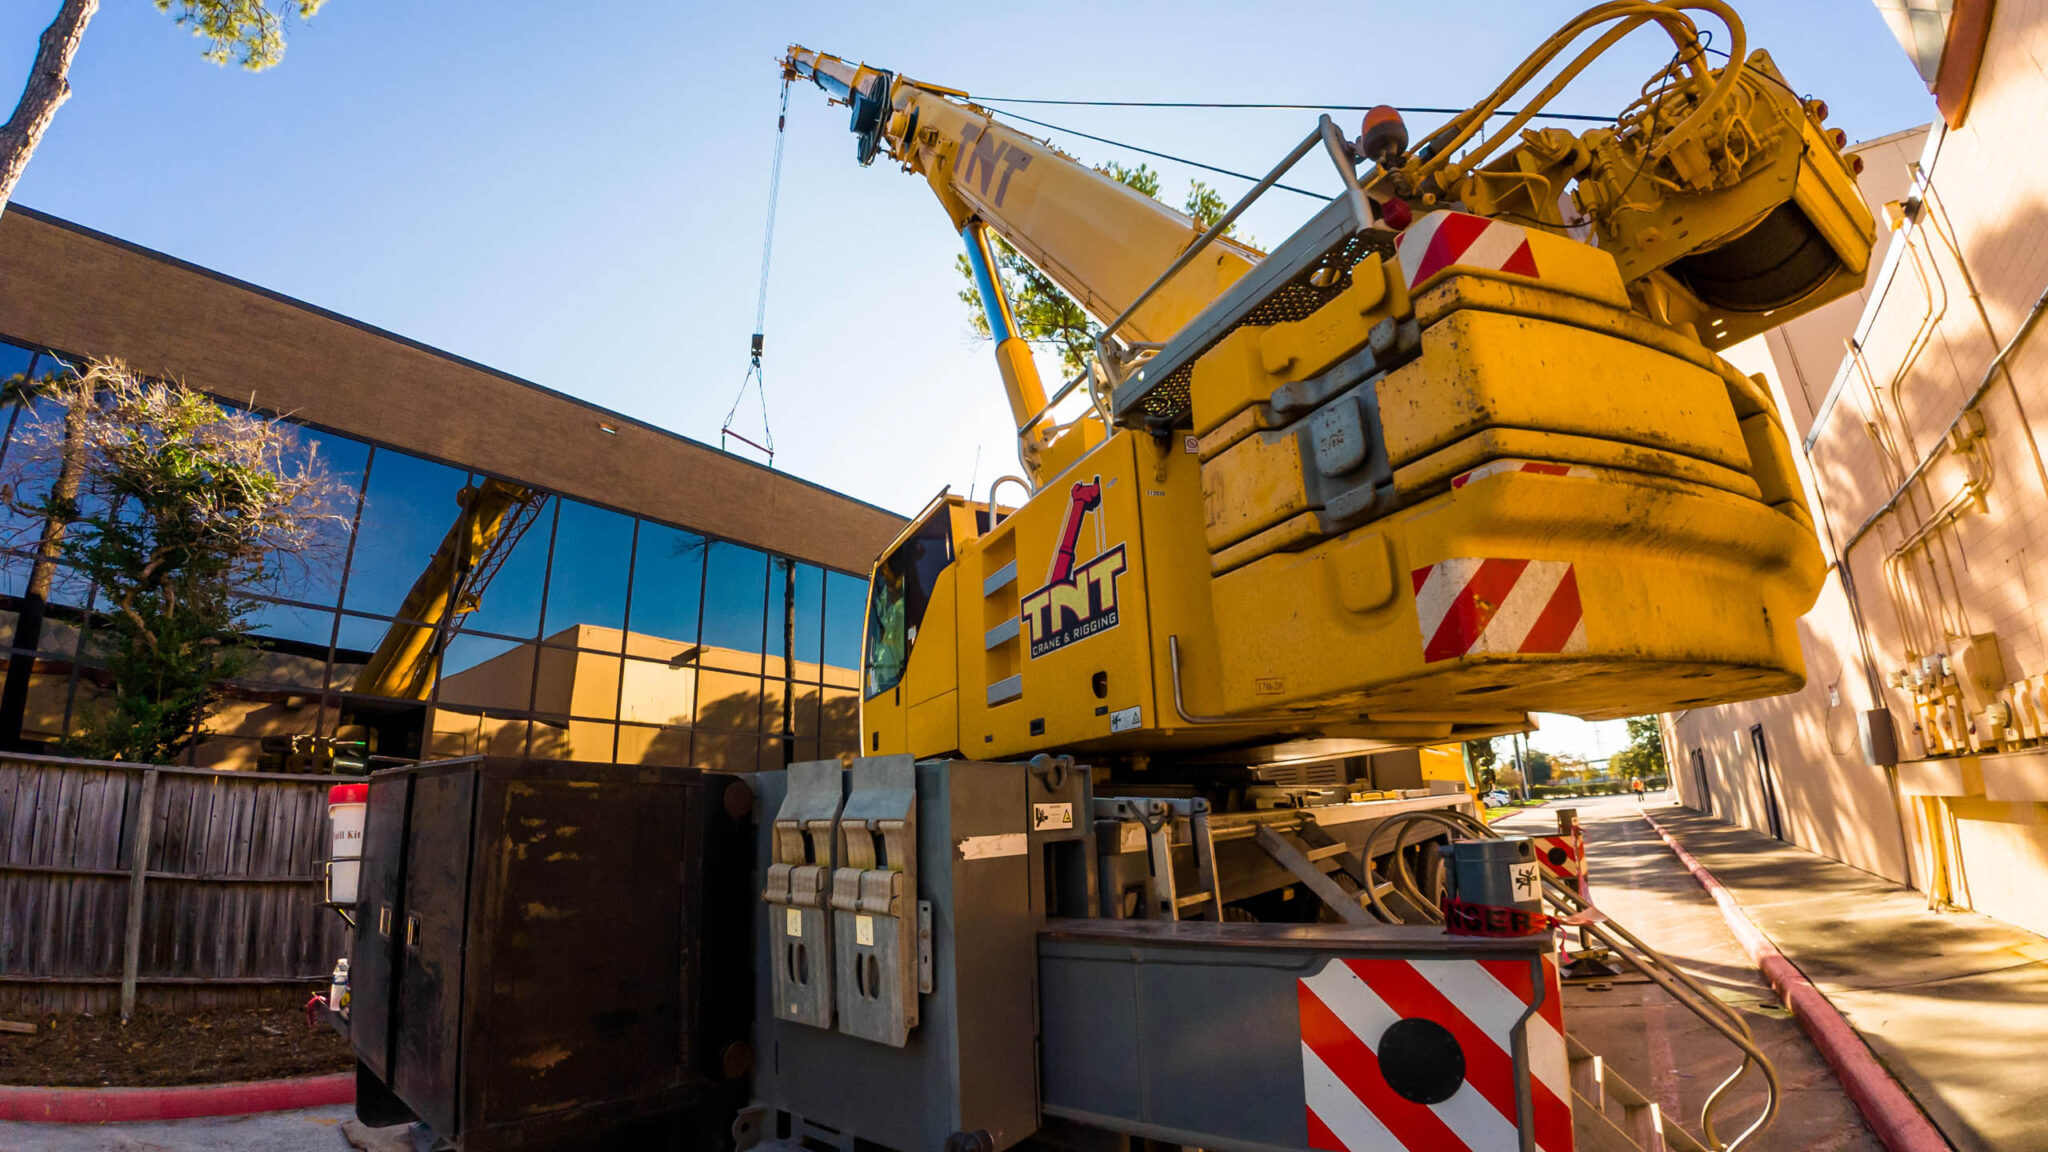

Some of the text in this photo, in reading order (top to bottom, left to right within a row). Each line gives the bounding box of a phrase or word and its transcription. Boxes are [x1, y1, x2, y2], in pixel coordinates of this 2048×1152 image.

[953, 121, 1033, 208] TNT
[1023, 550, 1124, 641] TNT
[1032, 612, 1117, 656] CRANE & RIGGING
[347, 830, 361, 840] Kit
